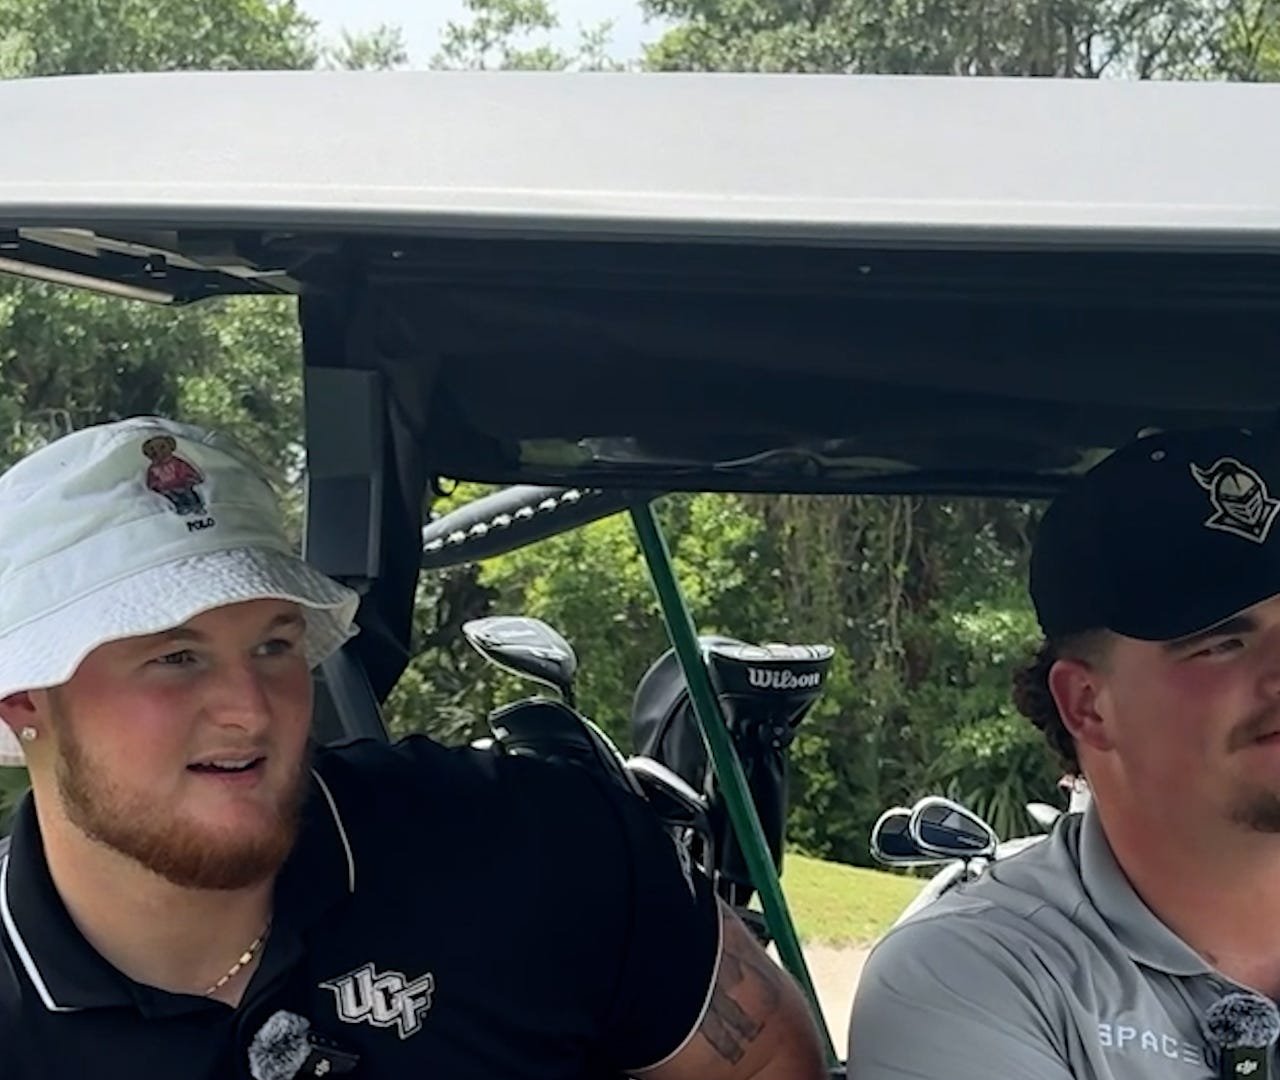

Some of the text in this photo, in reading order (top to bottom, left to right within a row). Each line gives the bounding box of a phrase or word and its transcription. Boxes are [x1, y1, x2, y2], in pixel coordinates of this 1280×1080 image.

[187, 518, 215, 532] POLO
[747, 667, 820, 690] Wilson
[318, 961, 436, 1040] UCF
